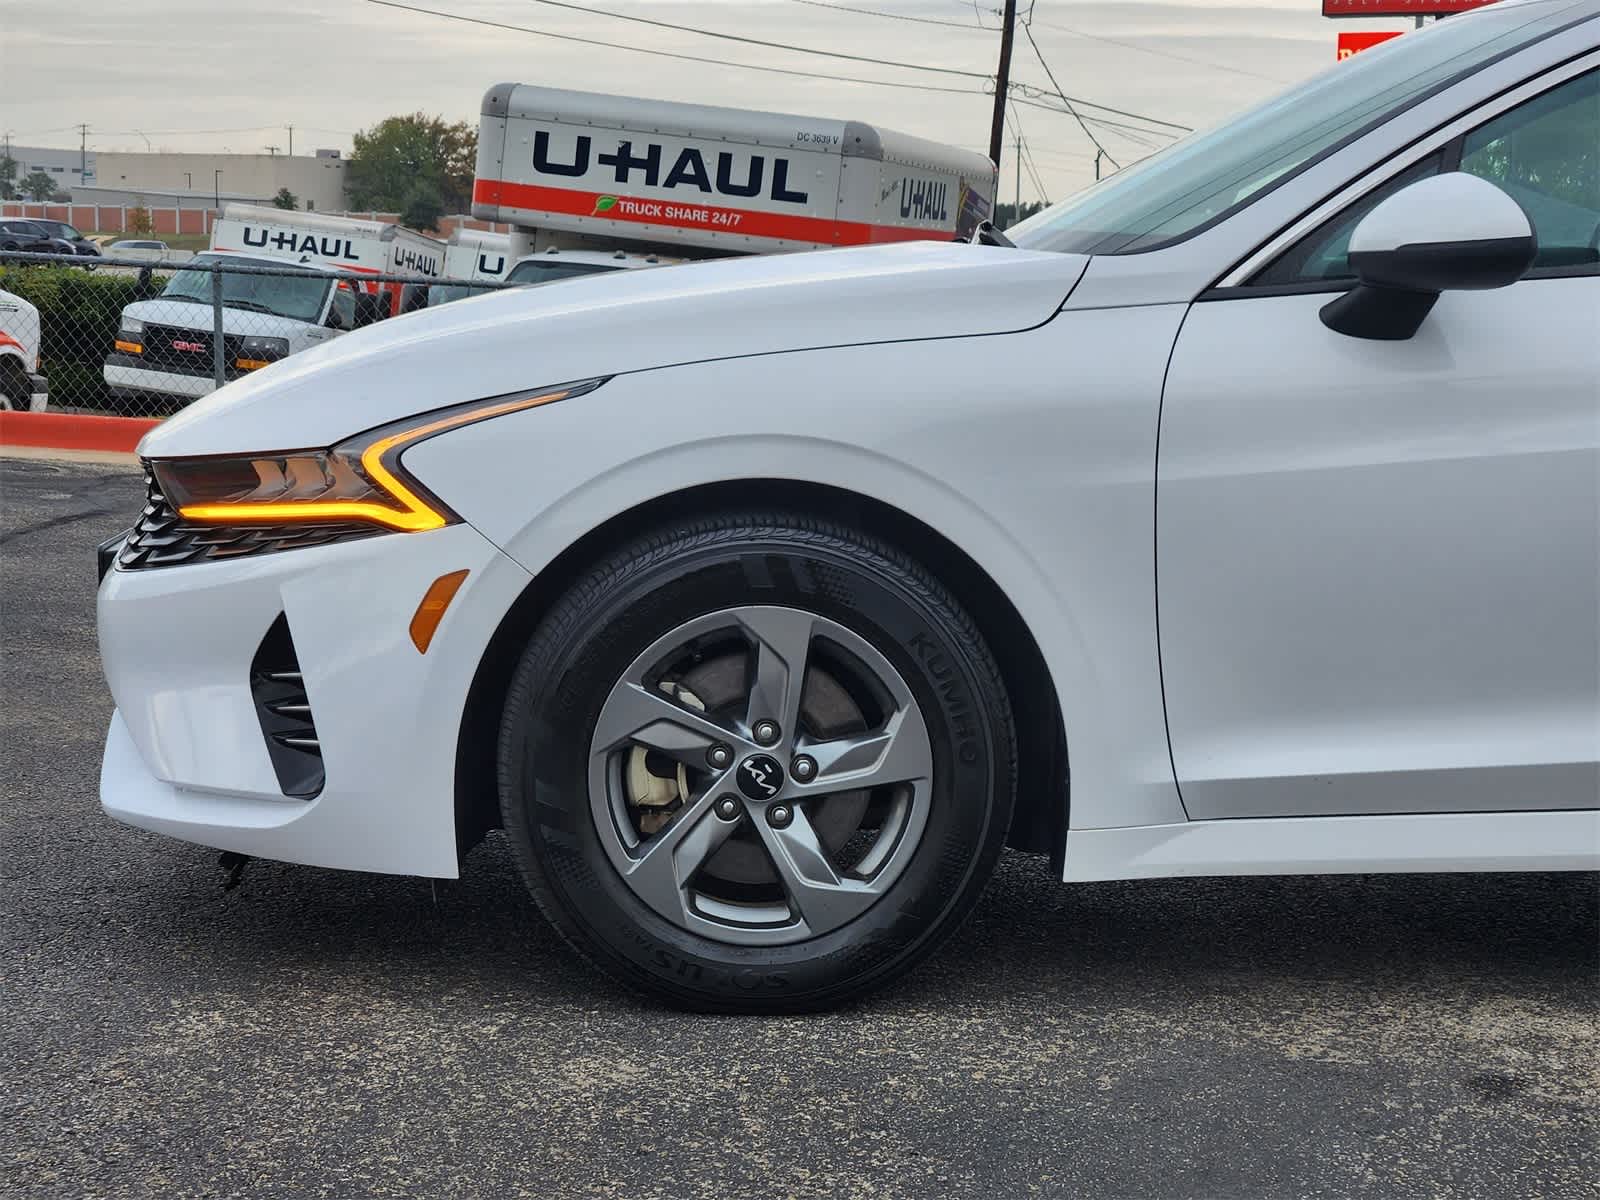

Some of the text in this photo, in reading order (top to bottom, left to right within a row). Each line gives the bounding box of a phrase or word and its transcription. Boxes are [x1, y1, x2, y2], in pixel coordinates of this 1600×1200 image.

[797, 132, 810, 142] DC
[533, 130, 808, 204] U-HAUL
[618, 200, 742, 226] TRUCK SHARE 24/7
[900, 177, 947, 221] U-HAUL
[243, 227, 359, 260] U-HAUL
[394, 246, 438, 277] U-HAUL
[172, 340, 205, 352] GMC
[908, 631, 977, 762] KUMHO
